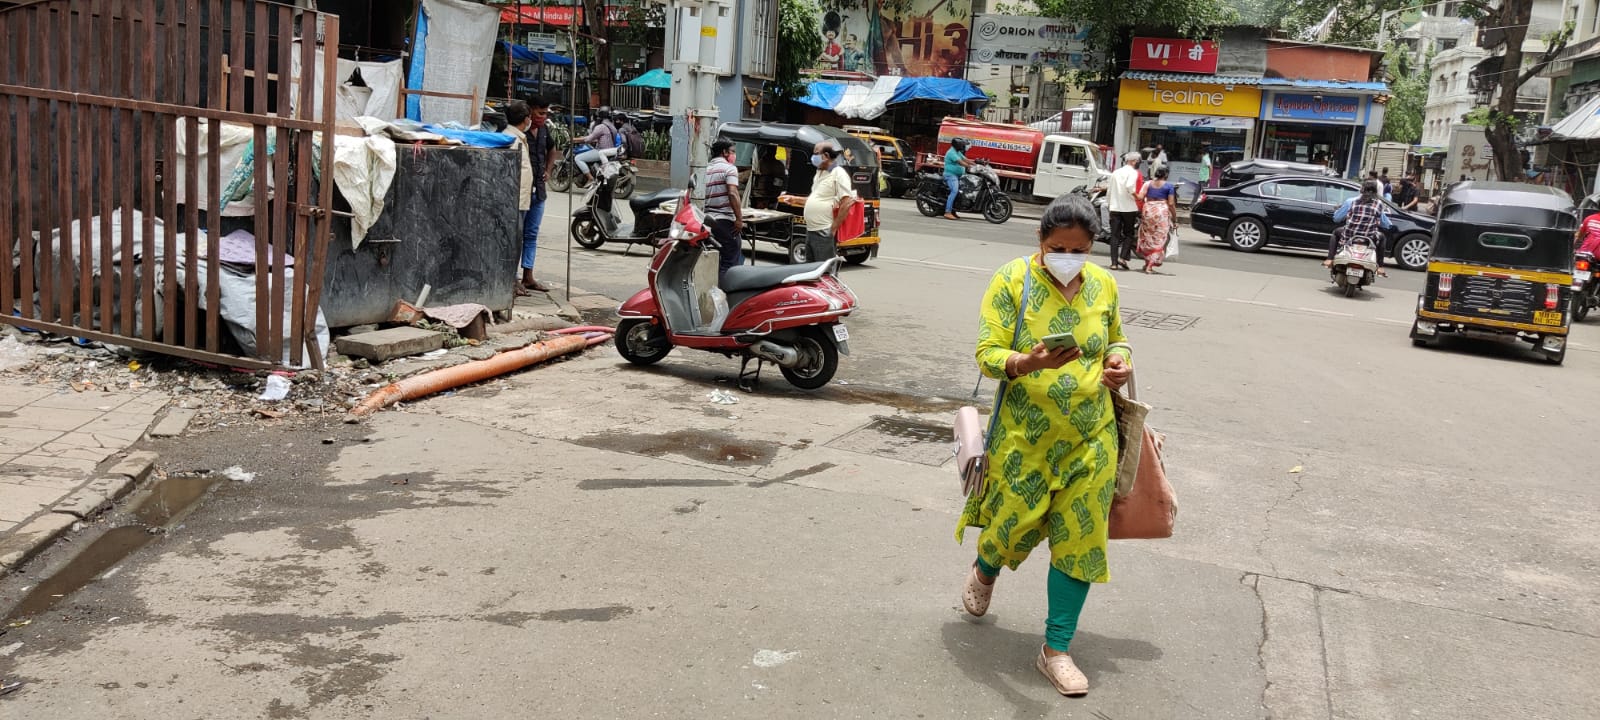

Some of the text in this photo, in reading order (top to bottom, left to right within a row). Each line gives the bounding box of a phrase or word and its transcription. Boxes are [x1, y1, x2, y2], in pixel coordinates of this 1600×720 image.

[533, 11, 563, 20] Mhindra
[999, 26, 1035, 37] ORION
[941, 22, 969, 66] 3
[1188, 44, 1204, 61] वी
[1153, 87, 1225, 107] realme
